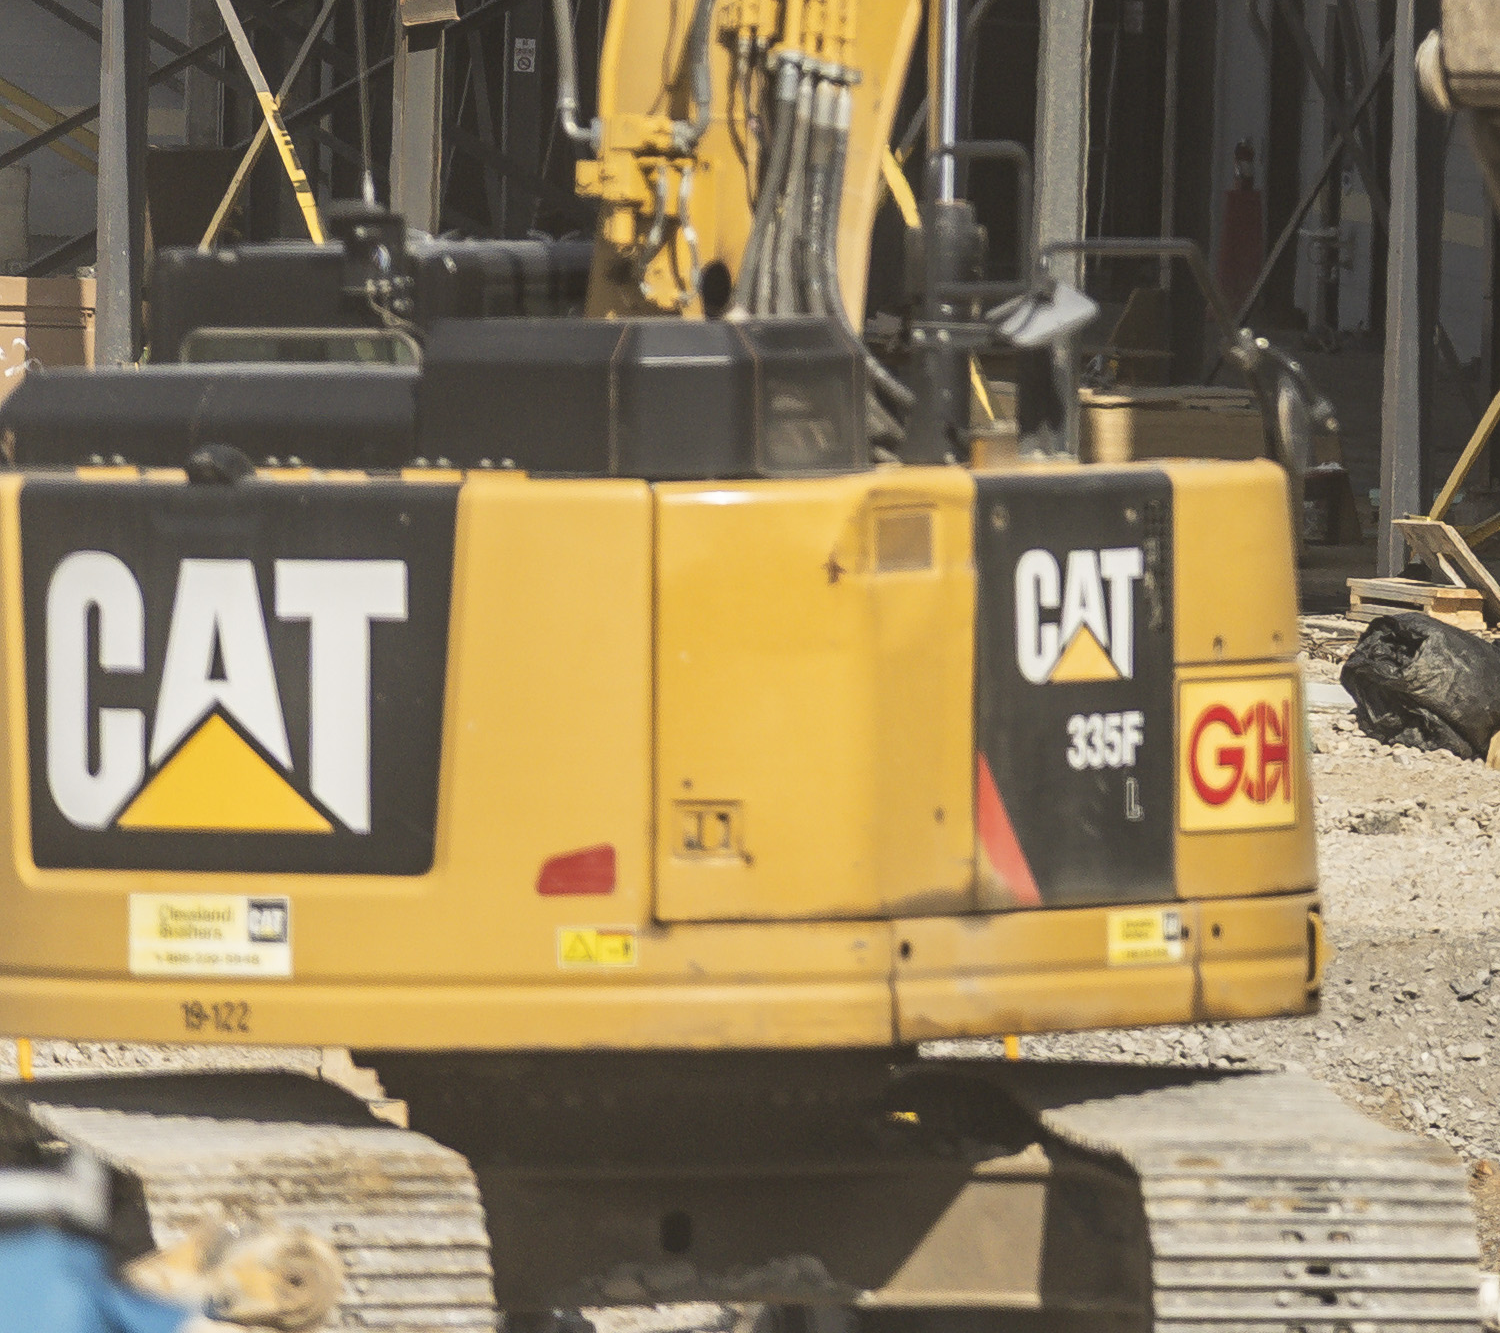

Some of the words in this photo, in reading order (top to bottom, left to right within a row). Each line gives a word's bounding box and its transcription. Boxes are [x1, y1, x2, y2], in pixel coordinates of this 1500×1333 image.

[1014, 547, 1144, 684] CAT
[45, 549, 408, 833] CAT
[1066, 711, 1145, 771] 335F
